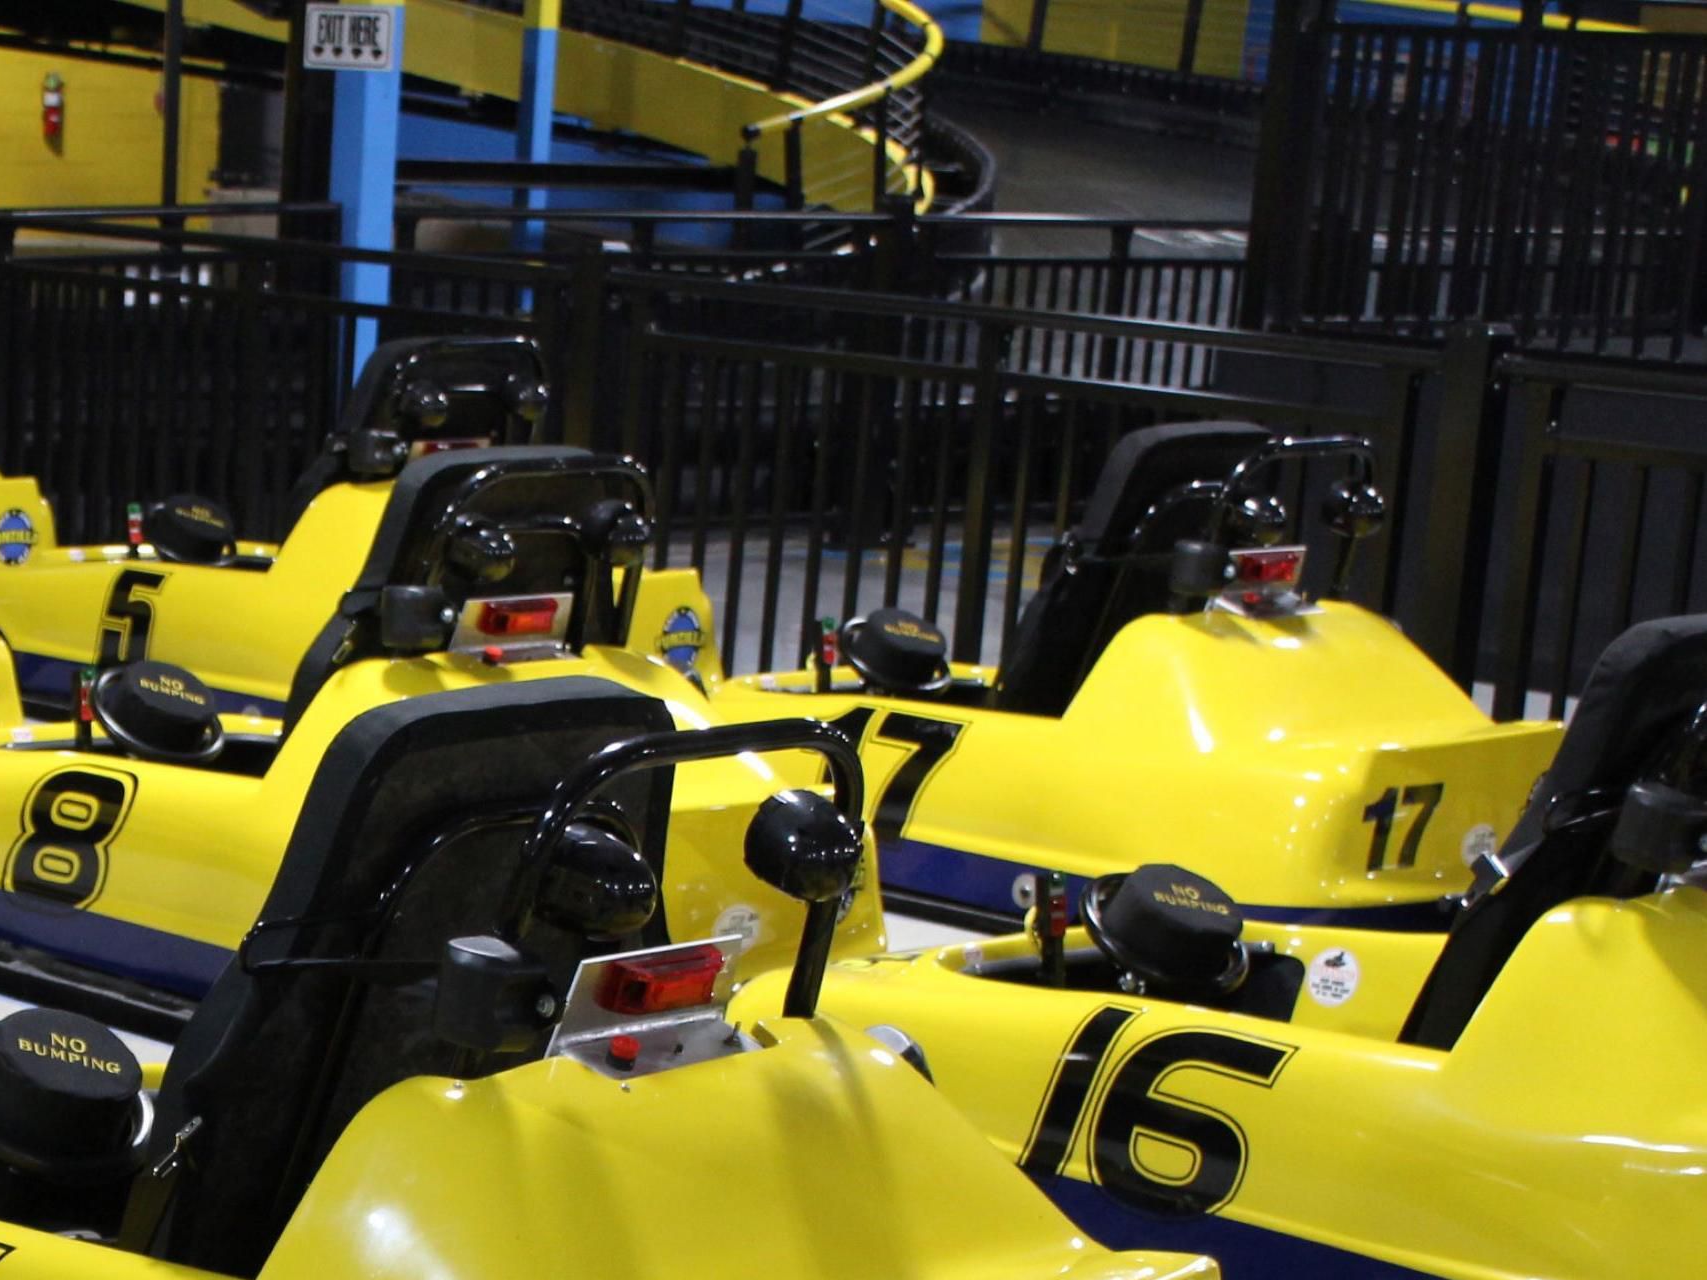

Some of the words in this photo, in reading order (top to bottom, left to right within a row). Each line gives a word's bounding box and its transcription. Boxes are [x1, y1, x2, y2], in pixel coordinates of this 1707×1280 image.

[317, 14, 345, 44] EXIT
[349, 15, 380, 47] HERE
[97, 569, 173, 668] 5
[2, 764, 139, 909] 8
[1363, 782, 1443, 872] 17
[18, 1037, 122, 1074] BUMPING
[50, 1032, 86, 1054] NO
[1017, 1002, 1299, 1217] 16
